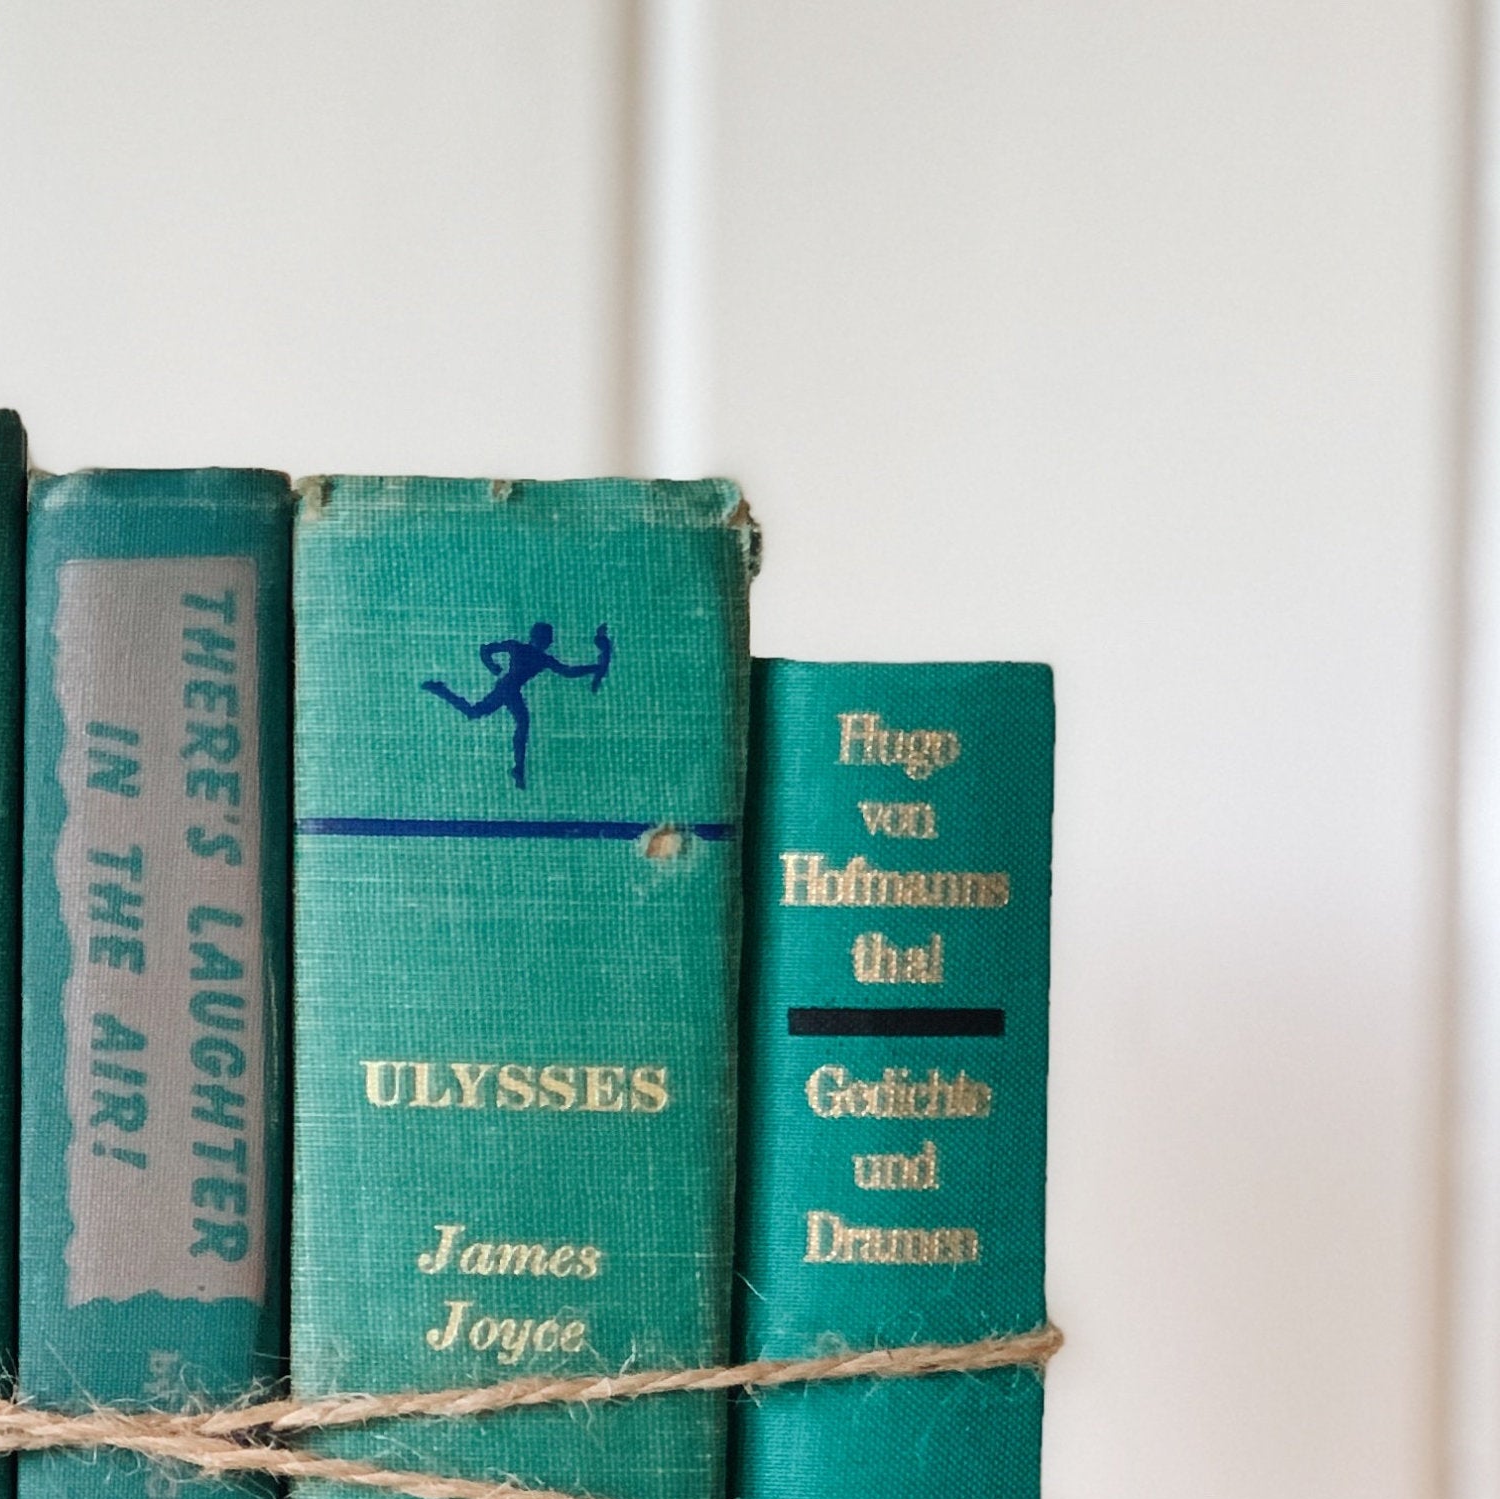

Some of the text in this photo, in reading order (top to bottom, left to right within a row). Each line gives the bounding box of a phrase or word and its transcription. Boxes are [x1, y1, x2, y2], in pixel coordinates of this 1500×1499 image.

[836, 711, 962, 780] Hugo
[856, 800, 940, 839] von
[779, 851, 1011, 907] Hofmanns
[85, 720, 151, 1171] IN THE AIR!
[180, 588, 251, 1265] THERE'S LAUGHTER
[850, 931, 946, 984] thal
[358, 1059, 671, 1113] ULYSSES
[804, 1063, 993, 1118] Gedichte
[852, 1138, 940, 1191] und
[417, 1223, 604, 1280] James
[803, 1209, 981, 1264] Dramen
[426, 1299, 590, 1366] Joyce
